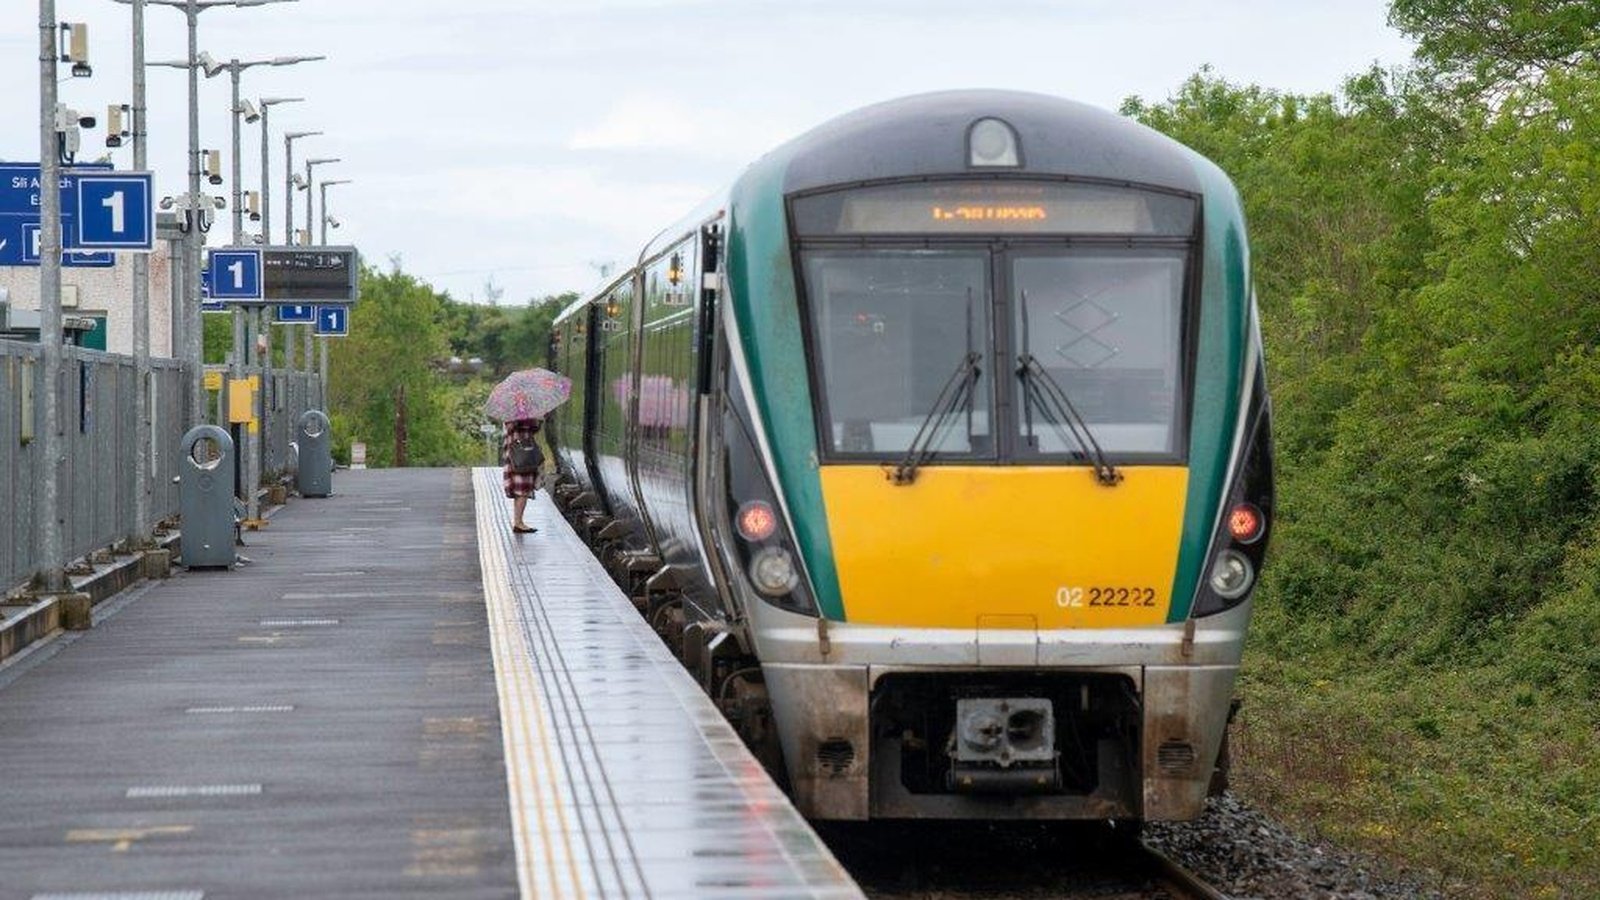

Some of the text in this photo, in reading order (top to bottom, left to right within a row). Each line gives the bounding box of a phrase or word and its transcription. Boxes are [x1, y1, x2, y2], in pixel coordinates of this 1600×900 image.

[30, 177, 72, 188] Ach
[102, 191, 124, 233] 1
[228, 260, 243, 288] 1
[328, 312, 337, 328] 1
[1057, 587, 1083, 607] 02
